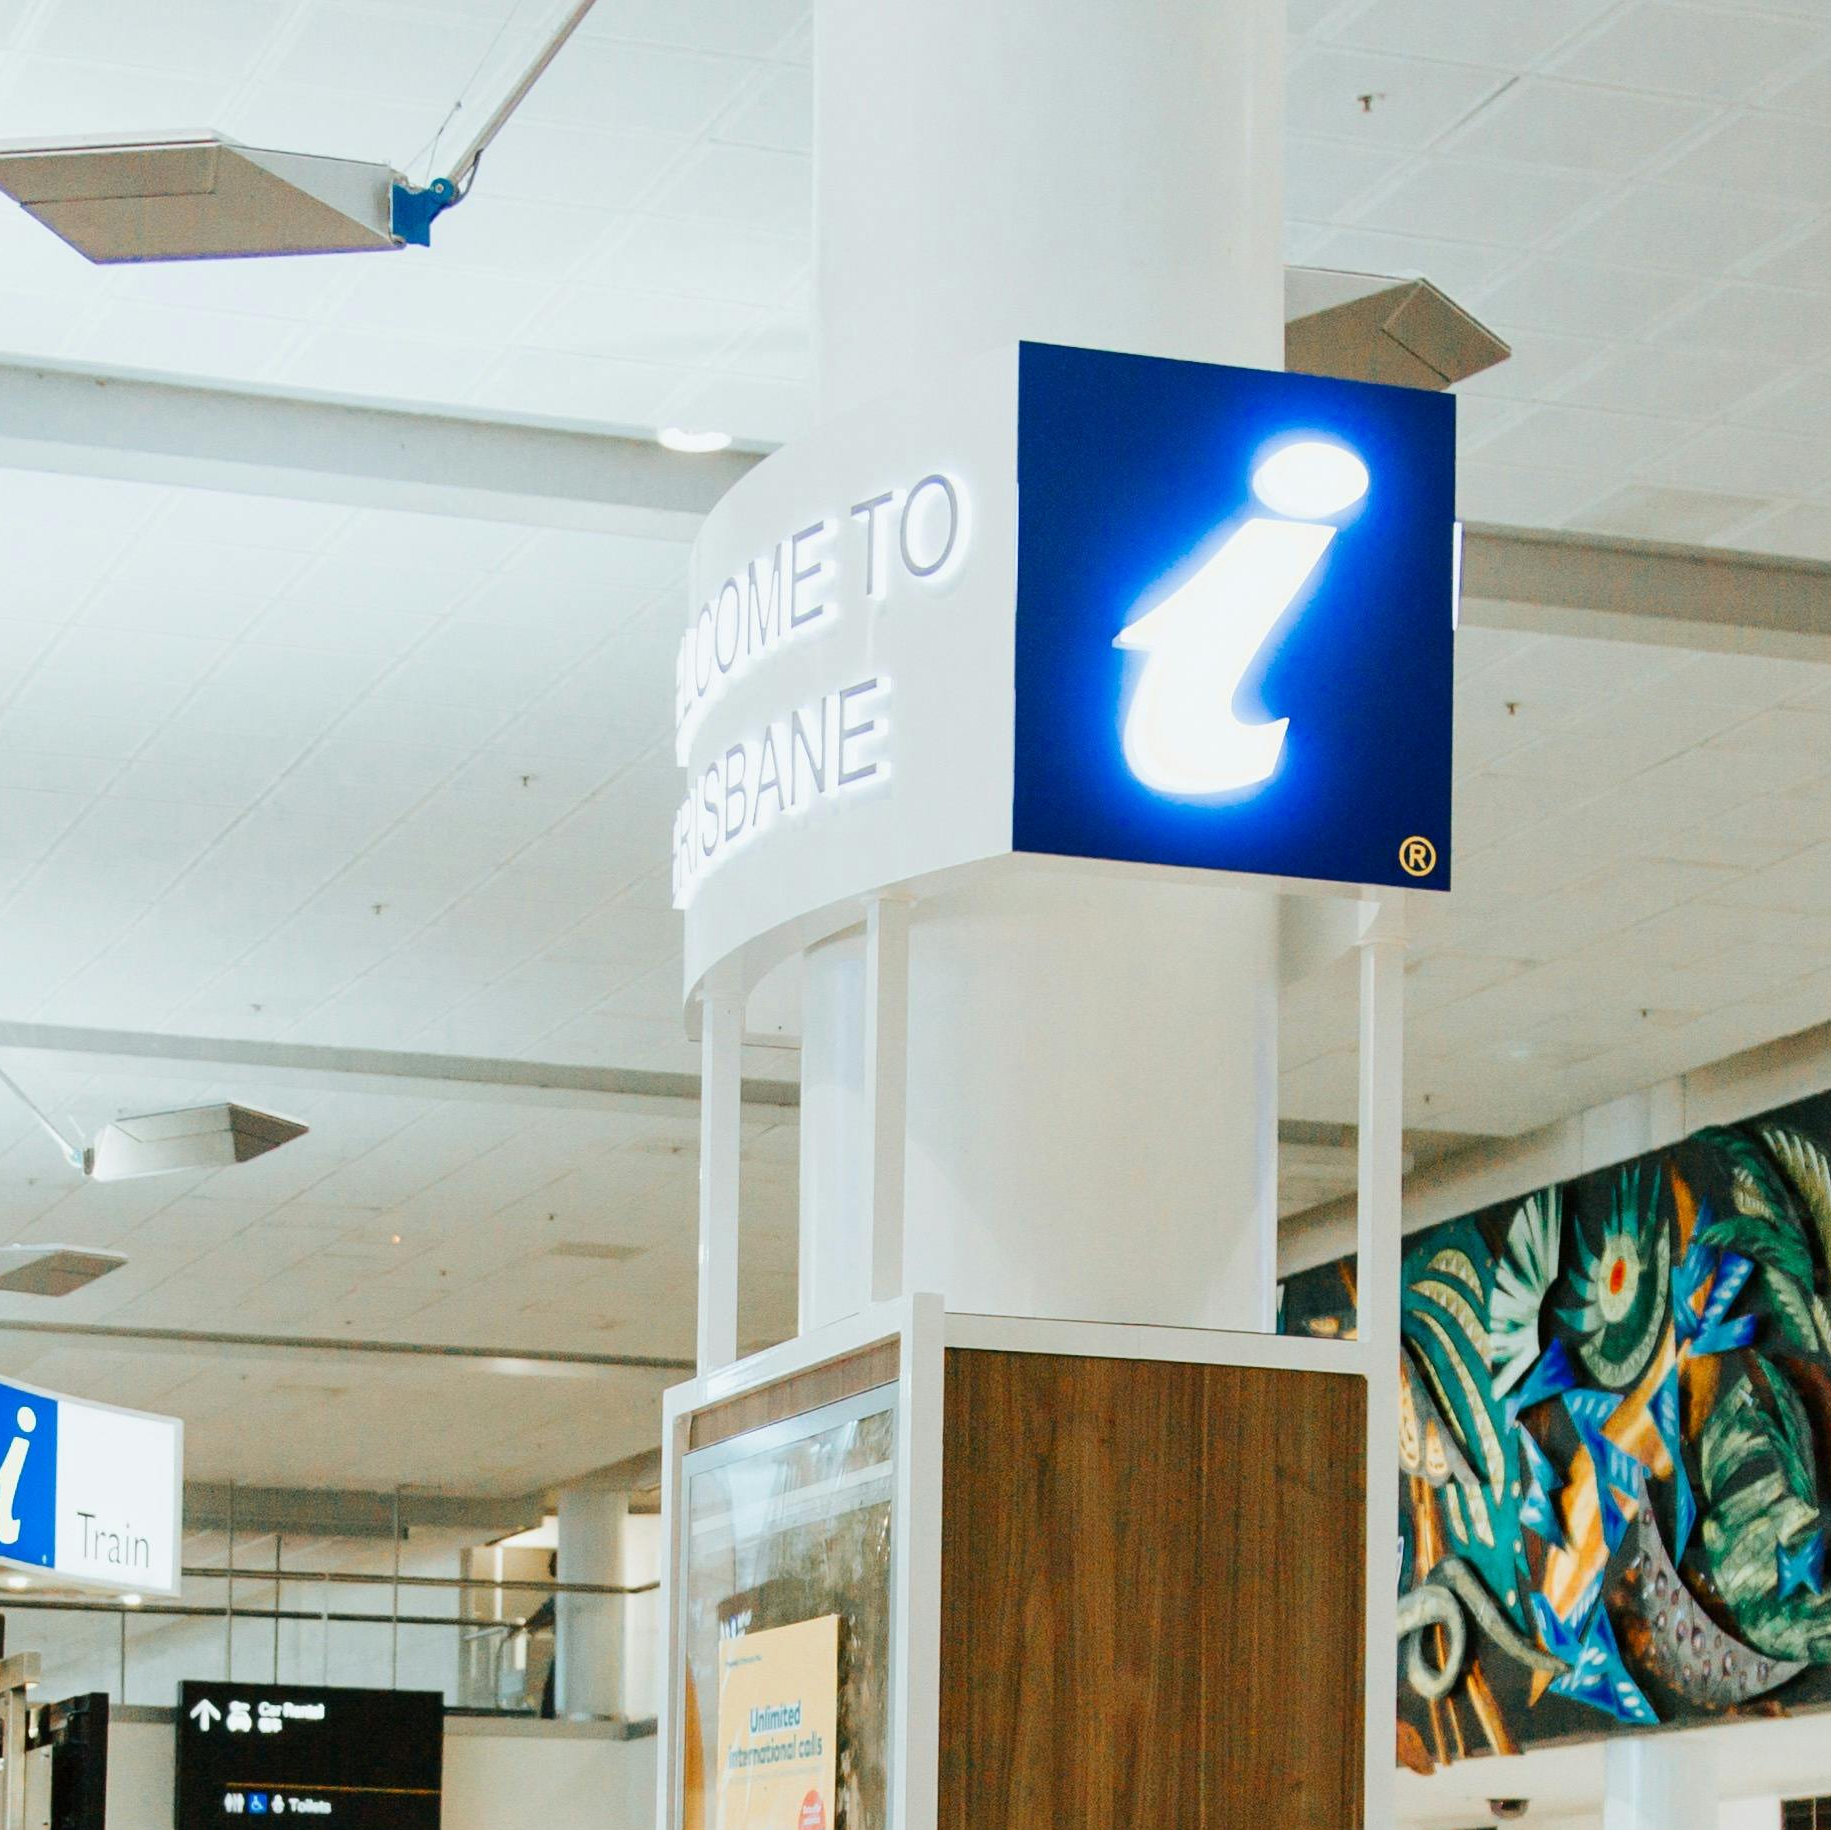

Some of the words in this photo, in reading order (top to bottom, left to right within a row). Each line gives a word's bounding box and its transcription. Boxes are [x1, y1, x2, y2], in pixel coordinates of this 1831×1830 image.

[851, 473, 960, 596] TO
[76, 1511, 152, 1570] Train
[749, 1700, 802, 1735] Unlimited
[727, 1732, 797, 1769] international
[798, 1730, 823, 1759] calls
